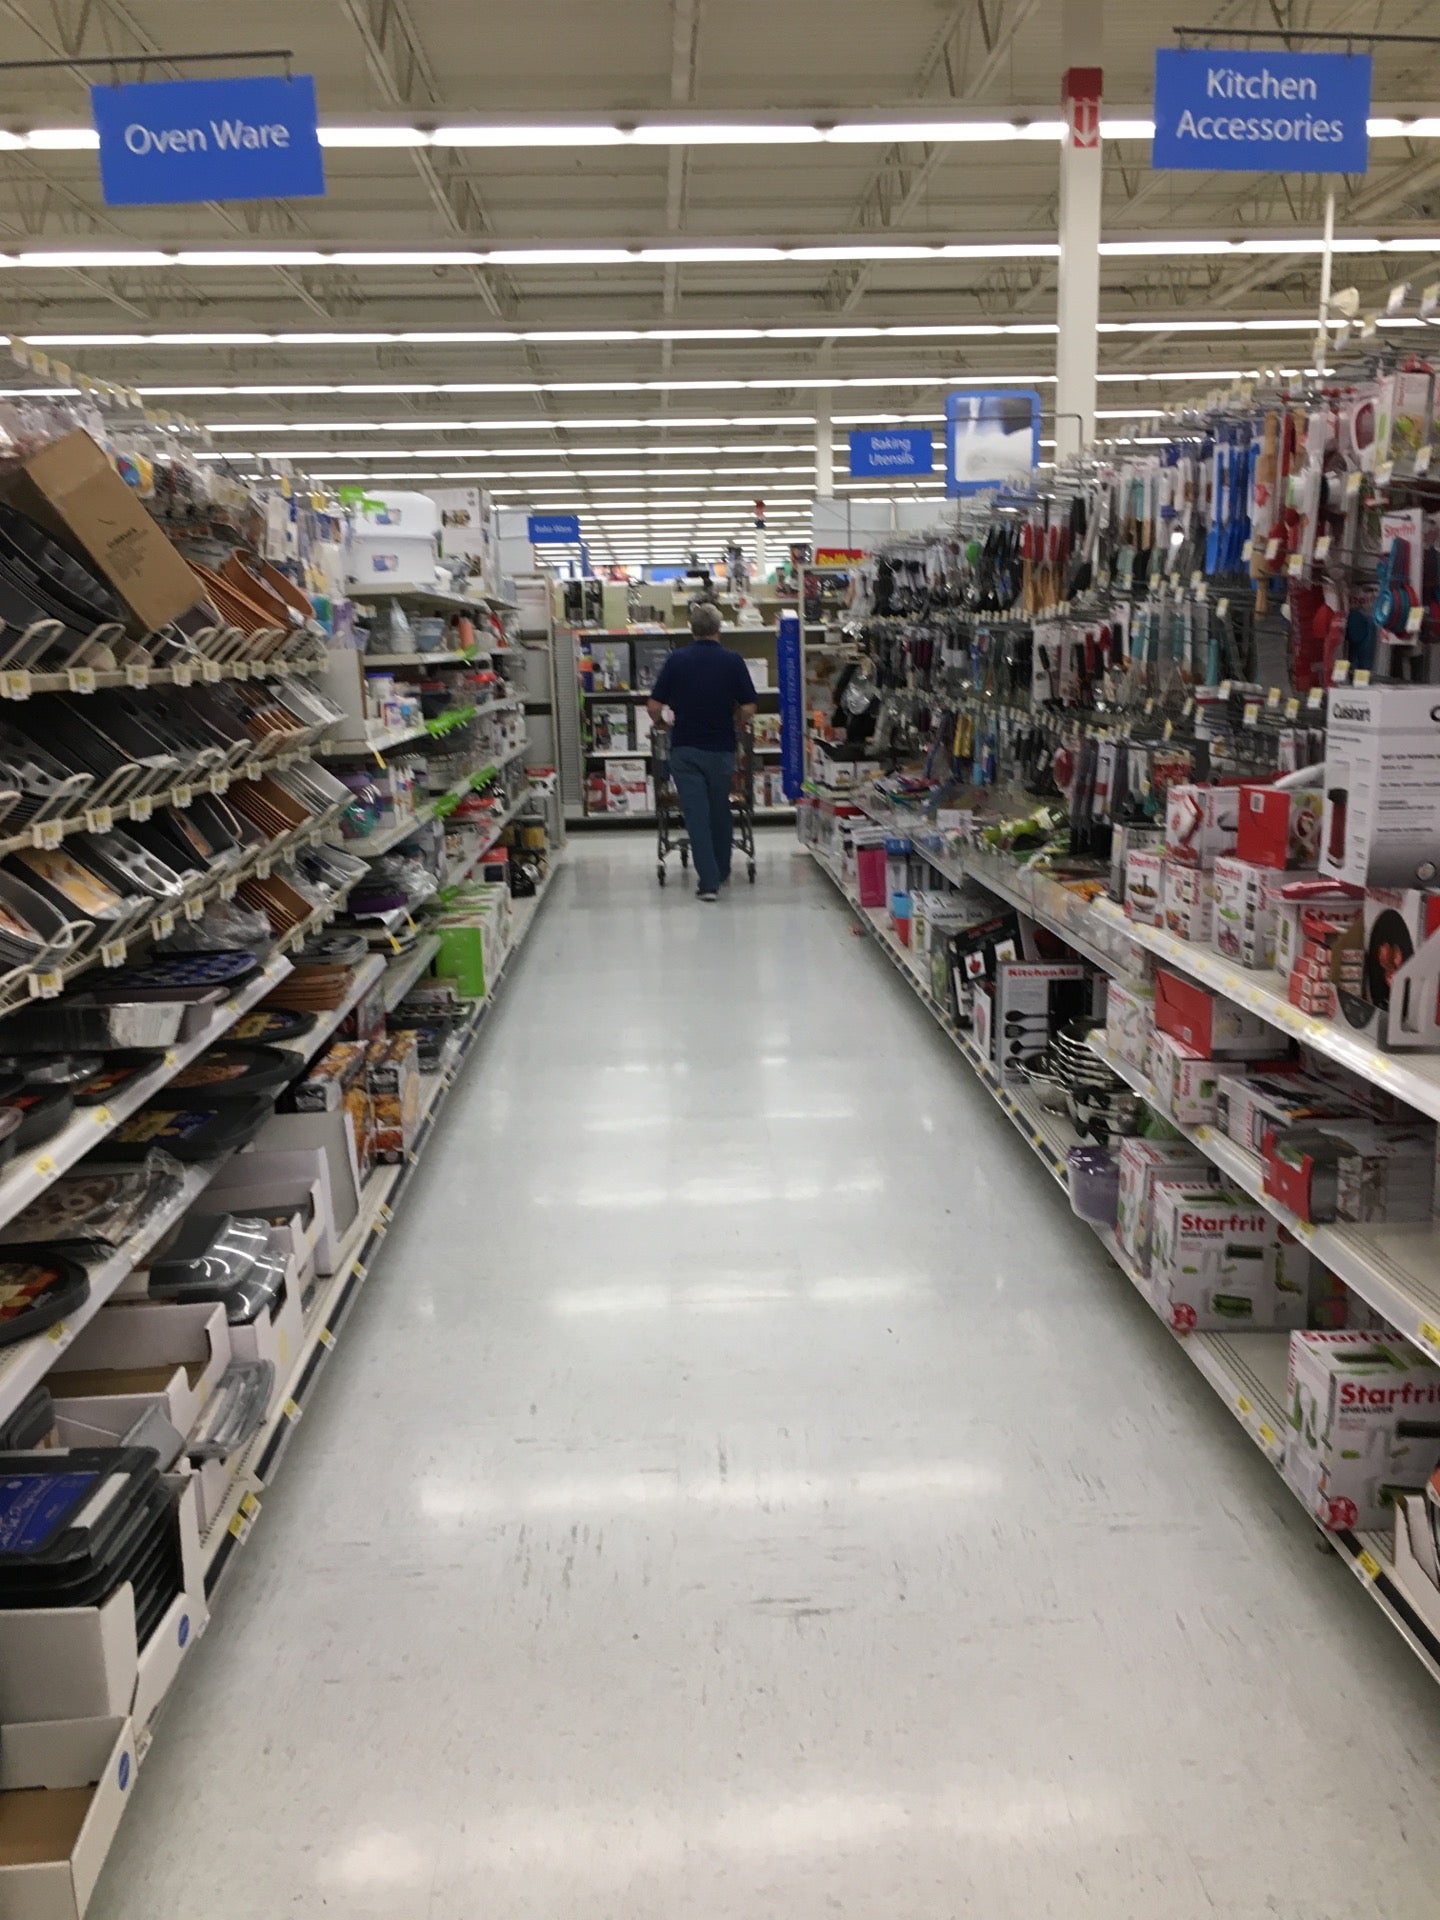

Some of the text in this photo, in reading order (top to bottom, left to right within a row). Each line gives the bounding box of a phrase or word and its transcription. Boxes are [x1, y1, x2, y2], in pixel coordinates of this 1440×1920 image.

[1206, 67, 1317, 101] Kitchen
[1175, 109, 1344, 143] Accessories
[124, 118, 290, 155] Oven Ware
[870, 436, 911, 451] Baking
[868, 451, 915, 466] Utensils
[1333, 703, 1371, 722] Cuisinart
[1008, 968, 1079, 977] KitchenAid
[1181, 1213, 1267, 1232] Starfrit
